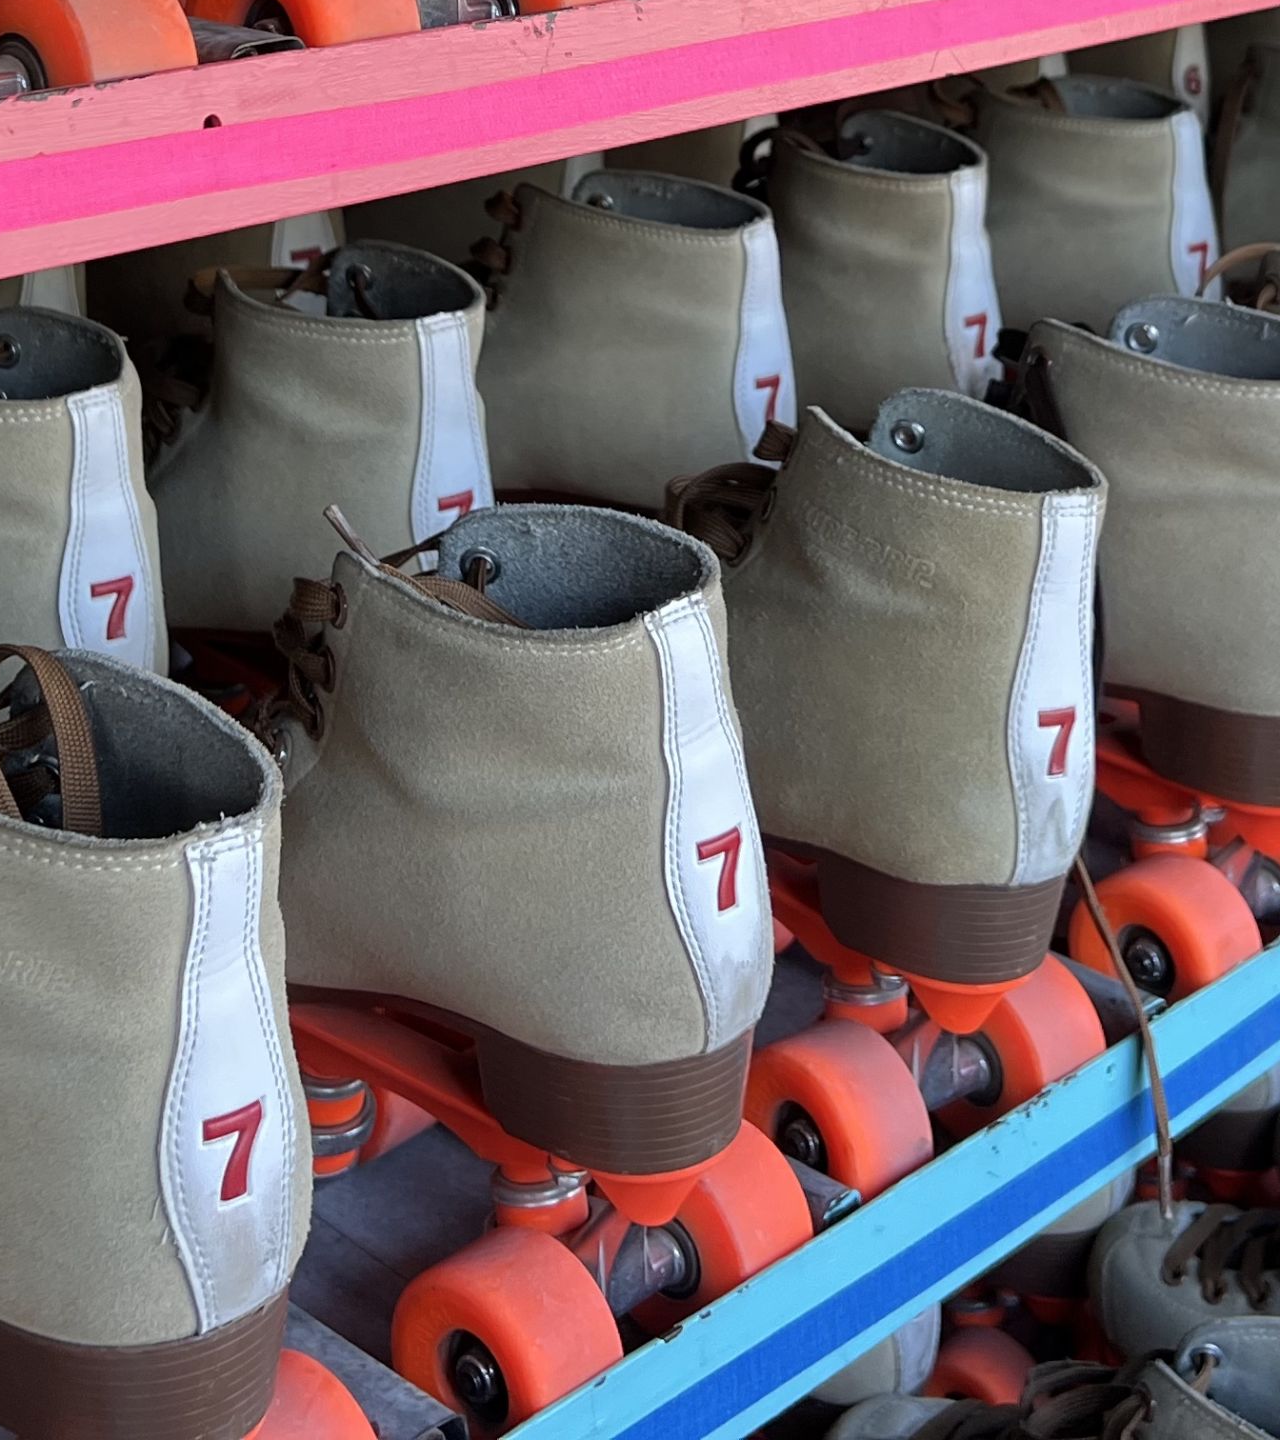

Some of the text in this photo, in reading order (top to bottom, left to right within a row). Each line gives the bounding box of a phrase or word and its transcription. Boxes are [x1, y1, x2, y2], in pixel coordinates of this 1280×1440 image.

[1190, 242, 1208, 280] 7
[966, 314, 988, 358] 7
[756, 376, 781, 420] 7
[90, 575, 134, 640] 7
[1039, 709, 1076, 776] 7
[698, 827, 742, 912] 7
[203, 1101, 263, 1203] 7
